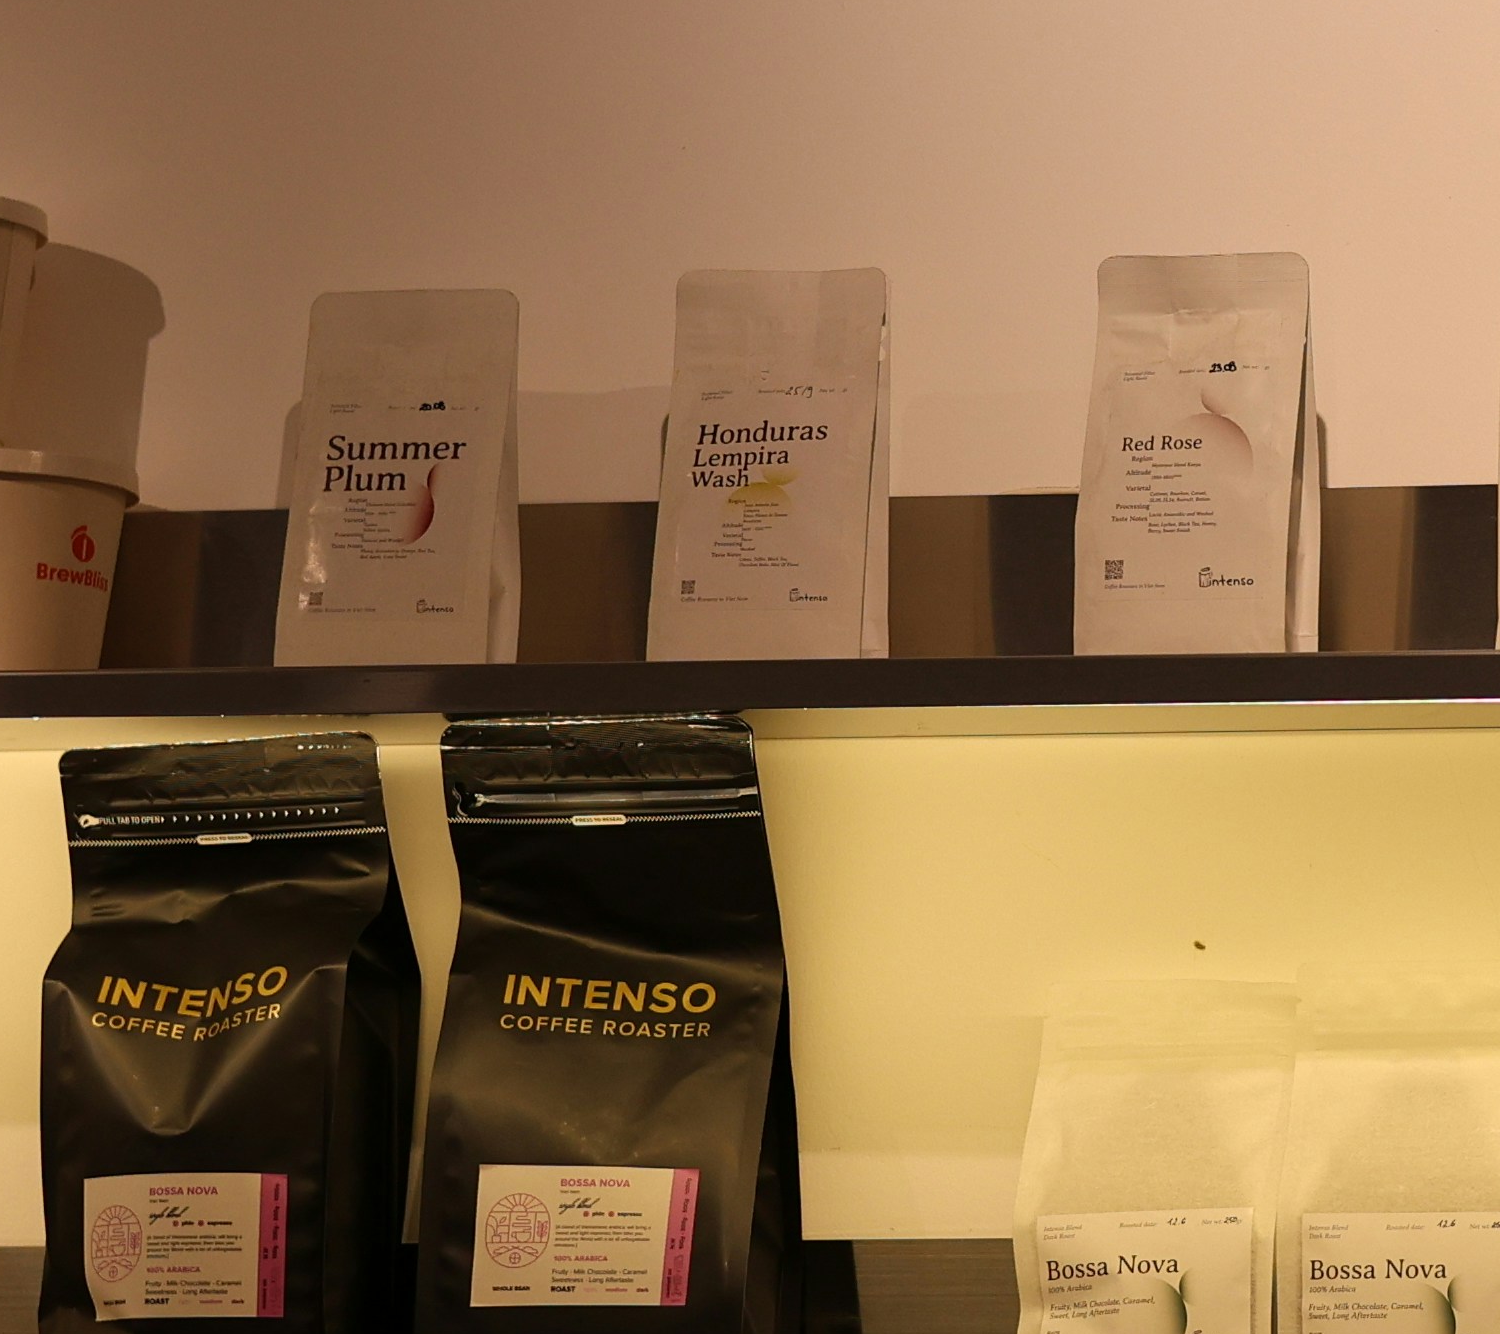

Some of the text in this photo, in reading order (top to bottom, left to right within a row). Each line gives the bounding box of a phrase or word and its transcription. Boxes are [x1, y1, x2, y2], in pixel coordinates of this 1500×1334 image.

[697, 420, 828, 445] Honduras
[326, 434, 467, 462] Summer
[1121, 435, 1203, 452] Red Rose
[693, 446, 789, 471] Lempira
[1131, 455, 1153, 463] Region
[323, 464, 406, 492] Plum
[692, 469, 749, 488] Wash
[1115, 503, 1150, 511] Processing
[100, 815, 161, 825] PULL TAB TO OPEN
[96, 965, 289, 1019] INTENSO
[502, 973, 717, 1014] INTENSO
[91, 1003, 282, 1042] COFFEE ROASTER
[500, 1013, 711, 1038] COFFEE ROASTER
[560, 1178, 631, 1188] BOSSA NOVA
[149, 1186, 218, 1196] BOSSA NOVA
[1046, 1254, 1179, 1281] Bossa Nova
[1310, 1258, 1447, 1281] Bossa Nova
[588, 1277, 603, 1285] Long
[550, 1285, 576, 1293] ROAST
[1048, 1283, 1093, 1295] 100% Arabica
[1309, 1285, 1356, 1294] 100% Arabica
[144, 1297, 170, 1305] ROAST
[1050, 1302, 1072, 1312] Fruity,
[1073, 1300, 1088, 1310] Milk
[1309, 1302, 1424, 1312] Fruity, Milk Chocolate, Caramel,
[1071, 1309, 1088, 1319] Long
[1089, 1307, 1121, 1317] Aftertaste
[1332, 1311, 1350, 1321] Long
[1351, 1310, 1388, 1321] Aftertaste
